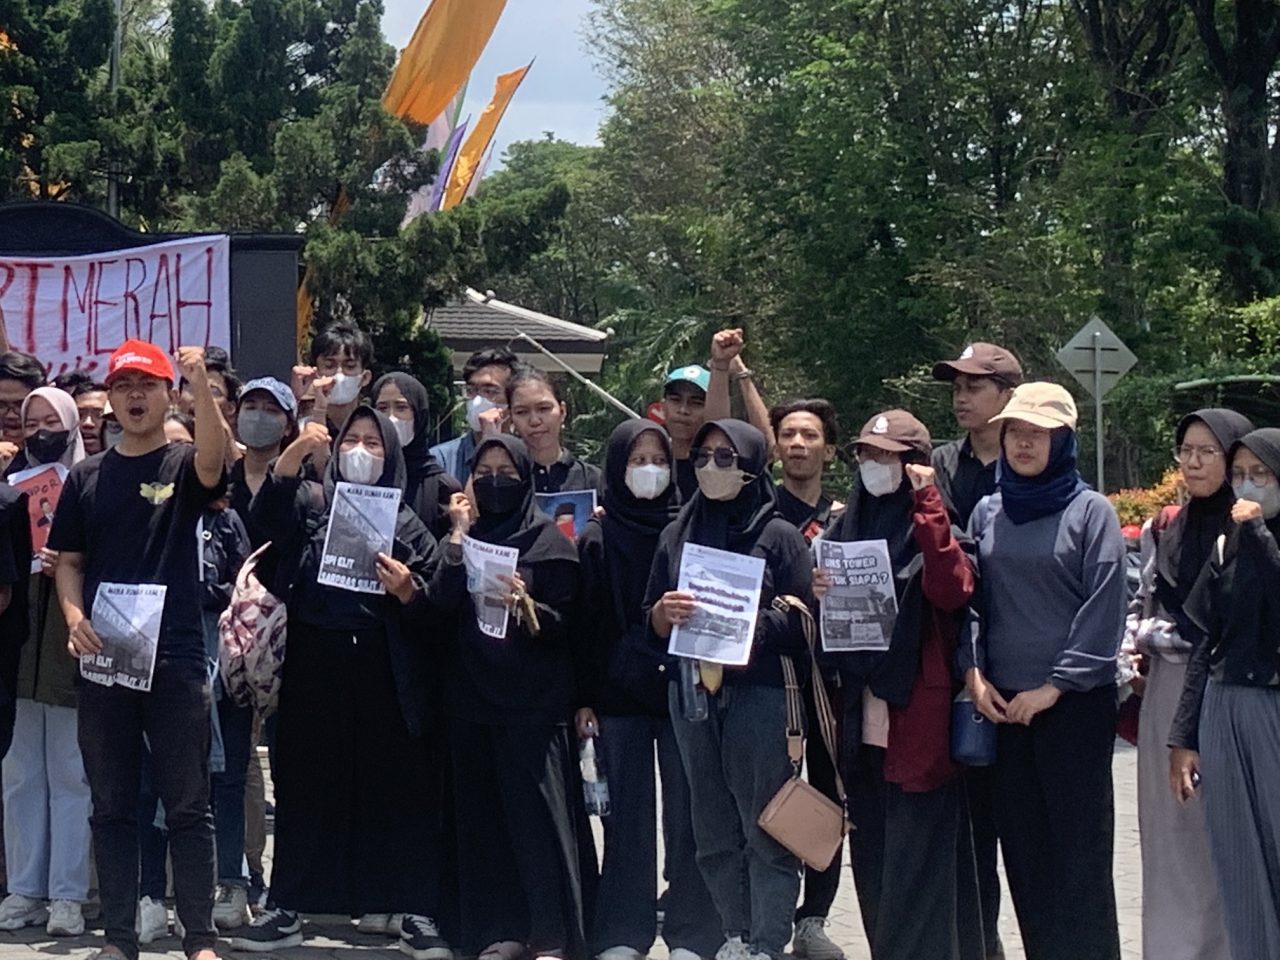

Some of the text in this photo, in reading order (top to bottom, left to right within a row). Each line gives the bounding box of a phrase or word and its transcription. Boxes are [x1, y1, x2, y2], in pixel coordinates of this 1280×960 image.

[61, 247, 213, 355] MERAH
[842, 556, 877, 570] TOWER
[849, 574, 878, 585] SIAPA
